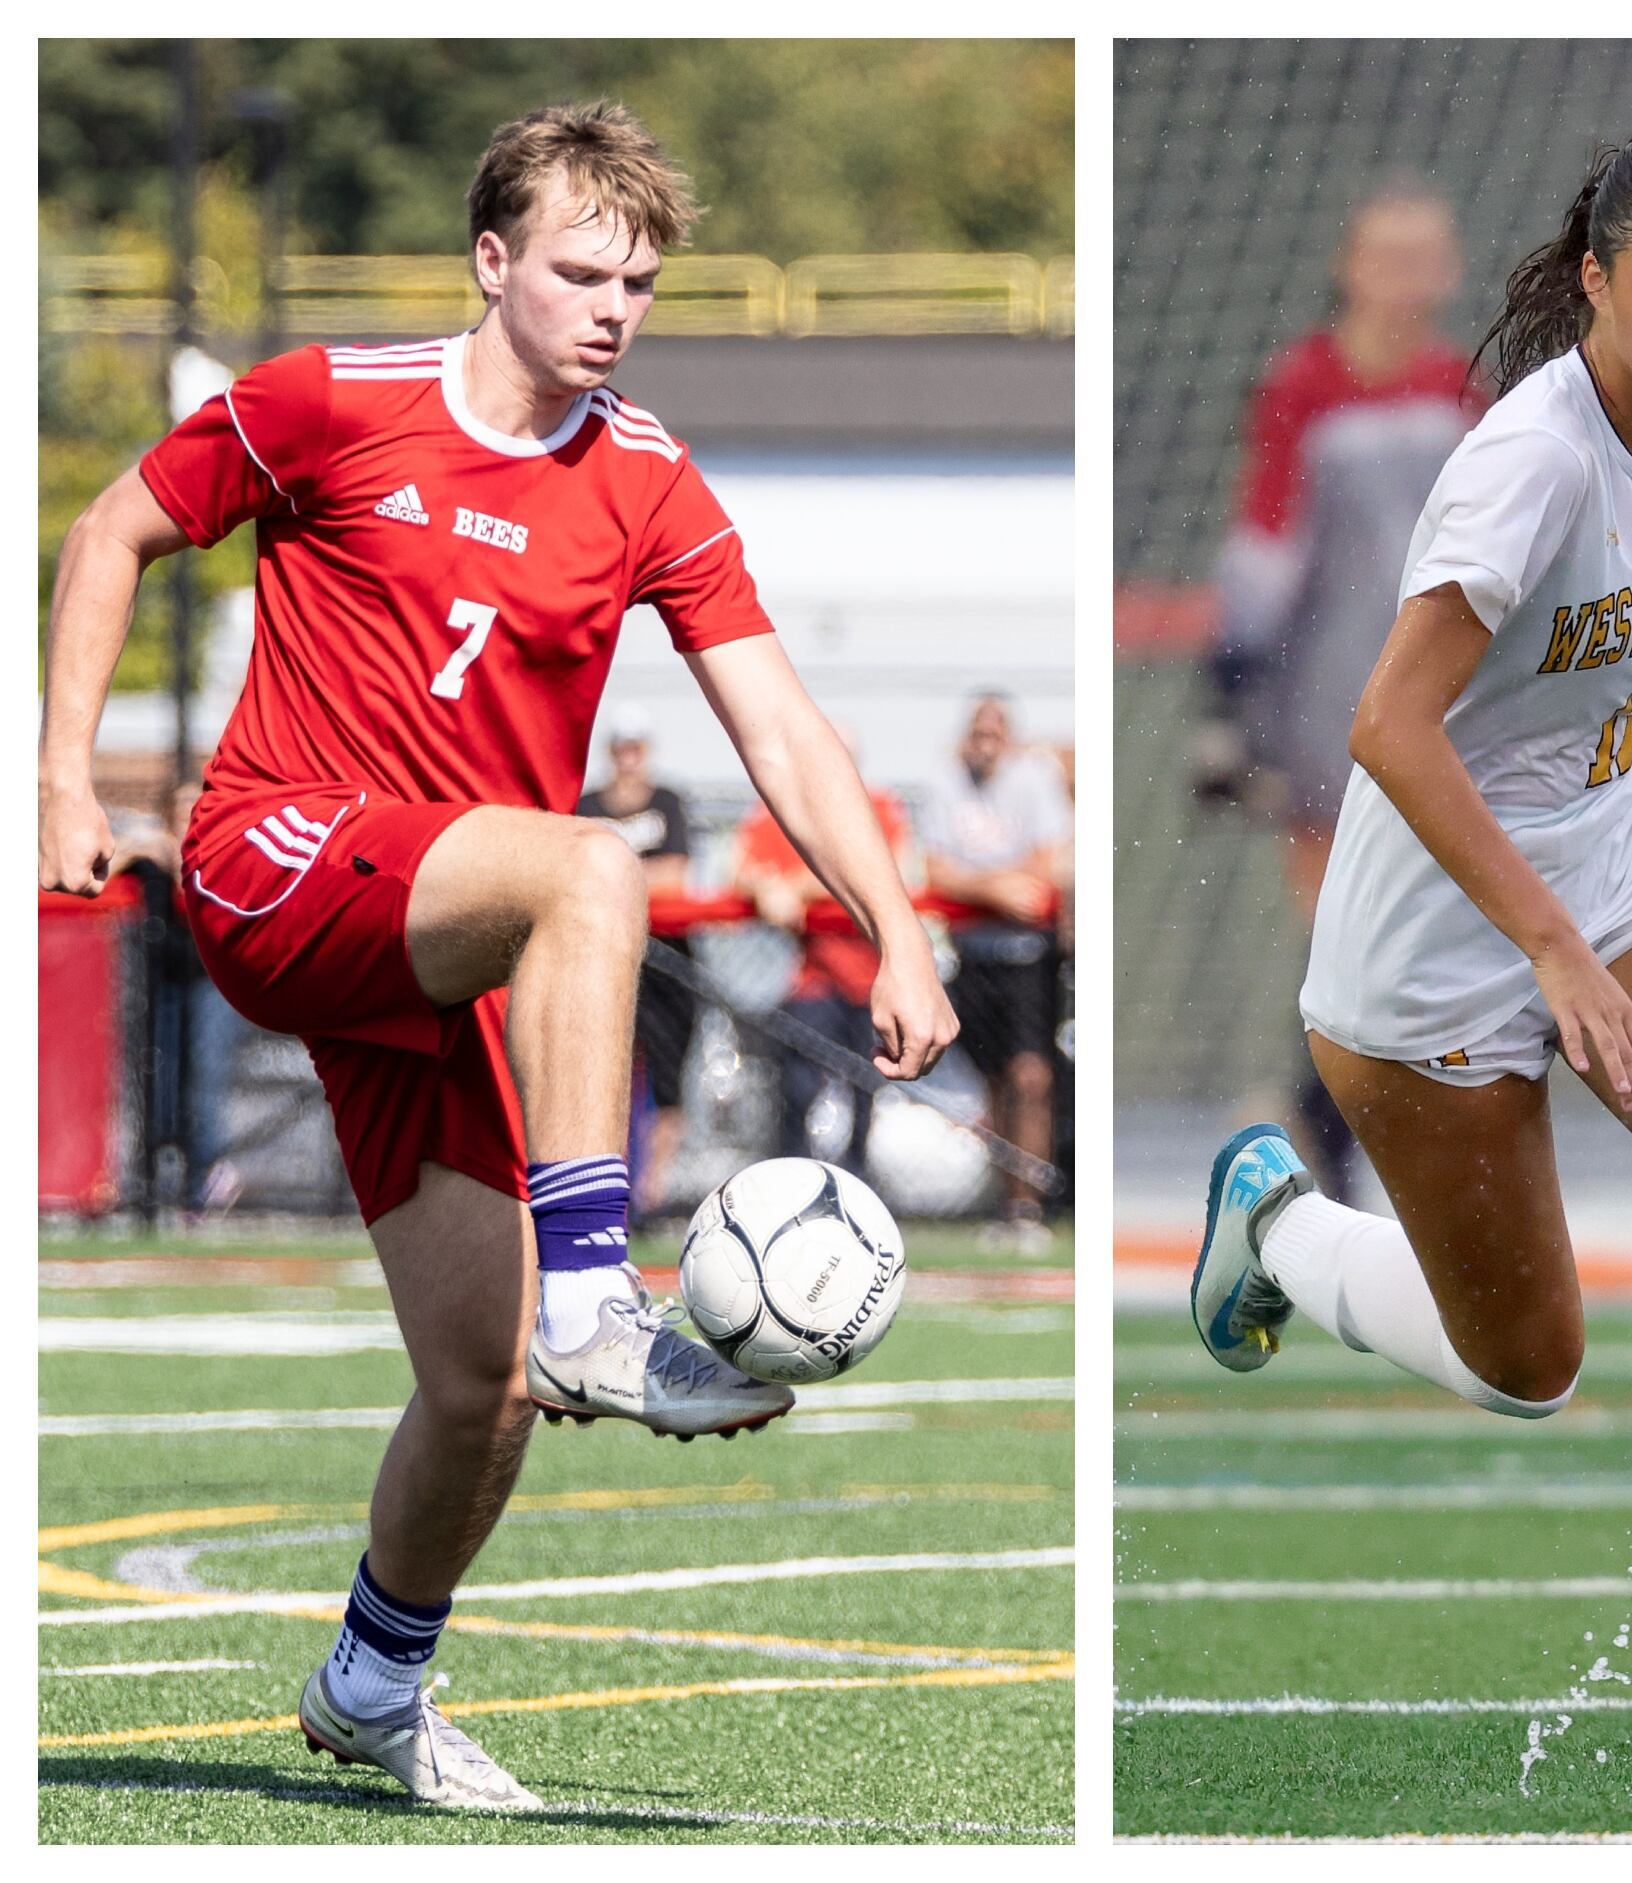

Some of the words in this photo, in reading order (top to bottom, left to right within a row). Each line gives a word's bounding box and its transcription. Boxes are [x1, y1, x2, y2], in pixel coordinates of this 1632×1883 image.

[374, 503, 430, 526] adidas
[452, 506, 529, 555] BEES
[430, 597, 499, 700] 7
[806, 1255, 841, 1304] TF-5000
[816, 1242, 895, 1362] SPALDING
